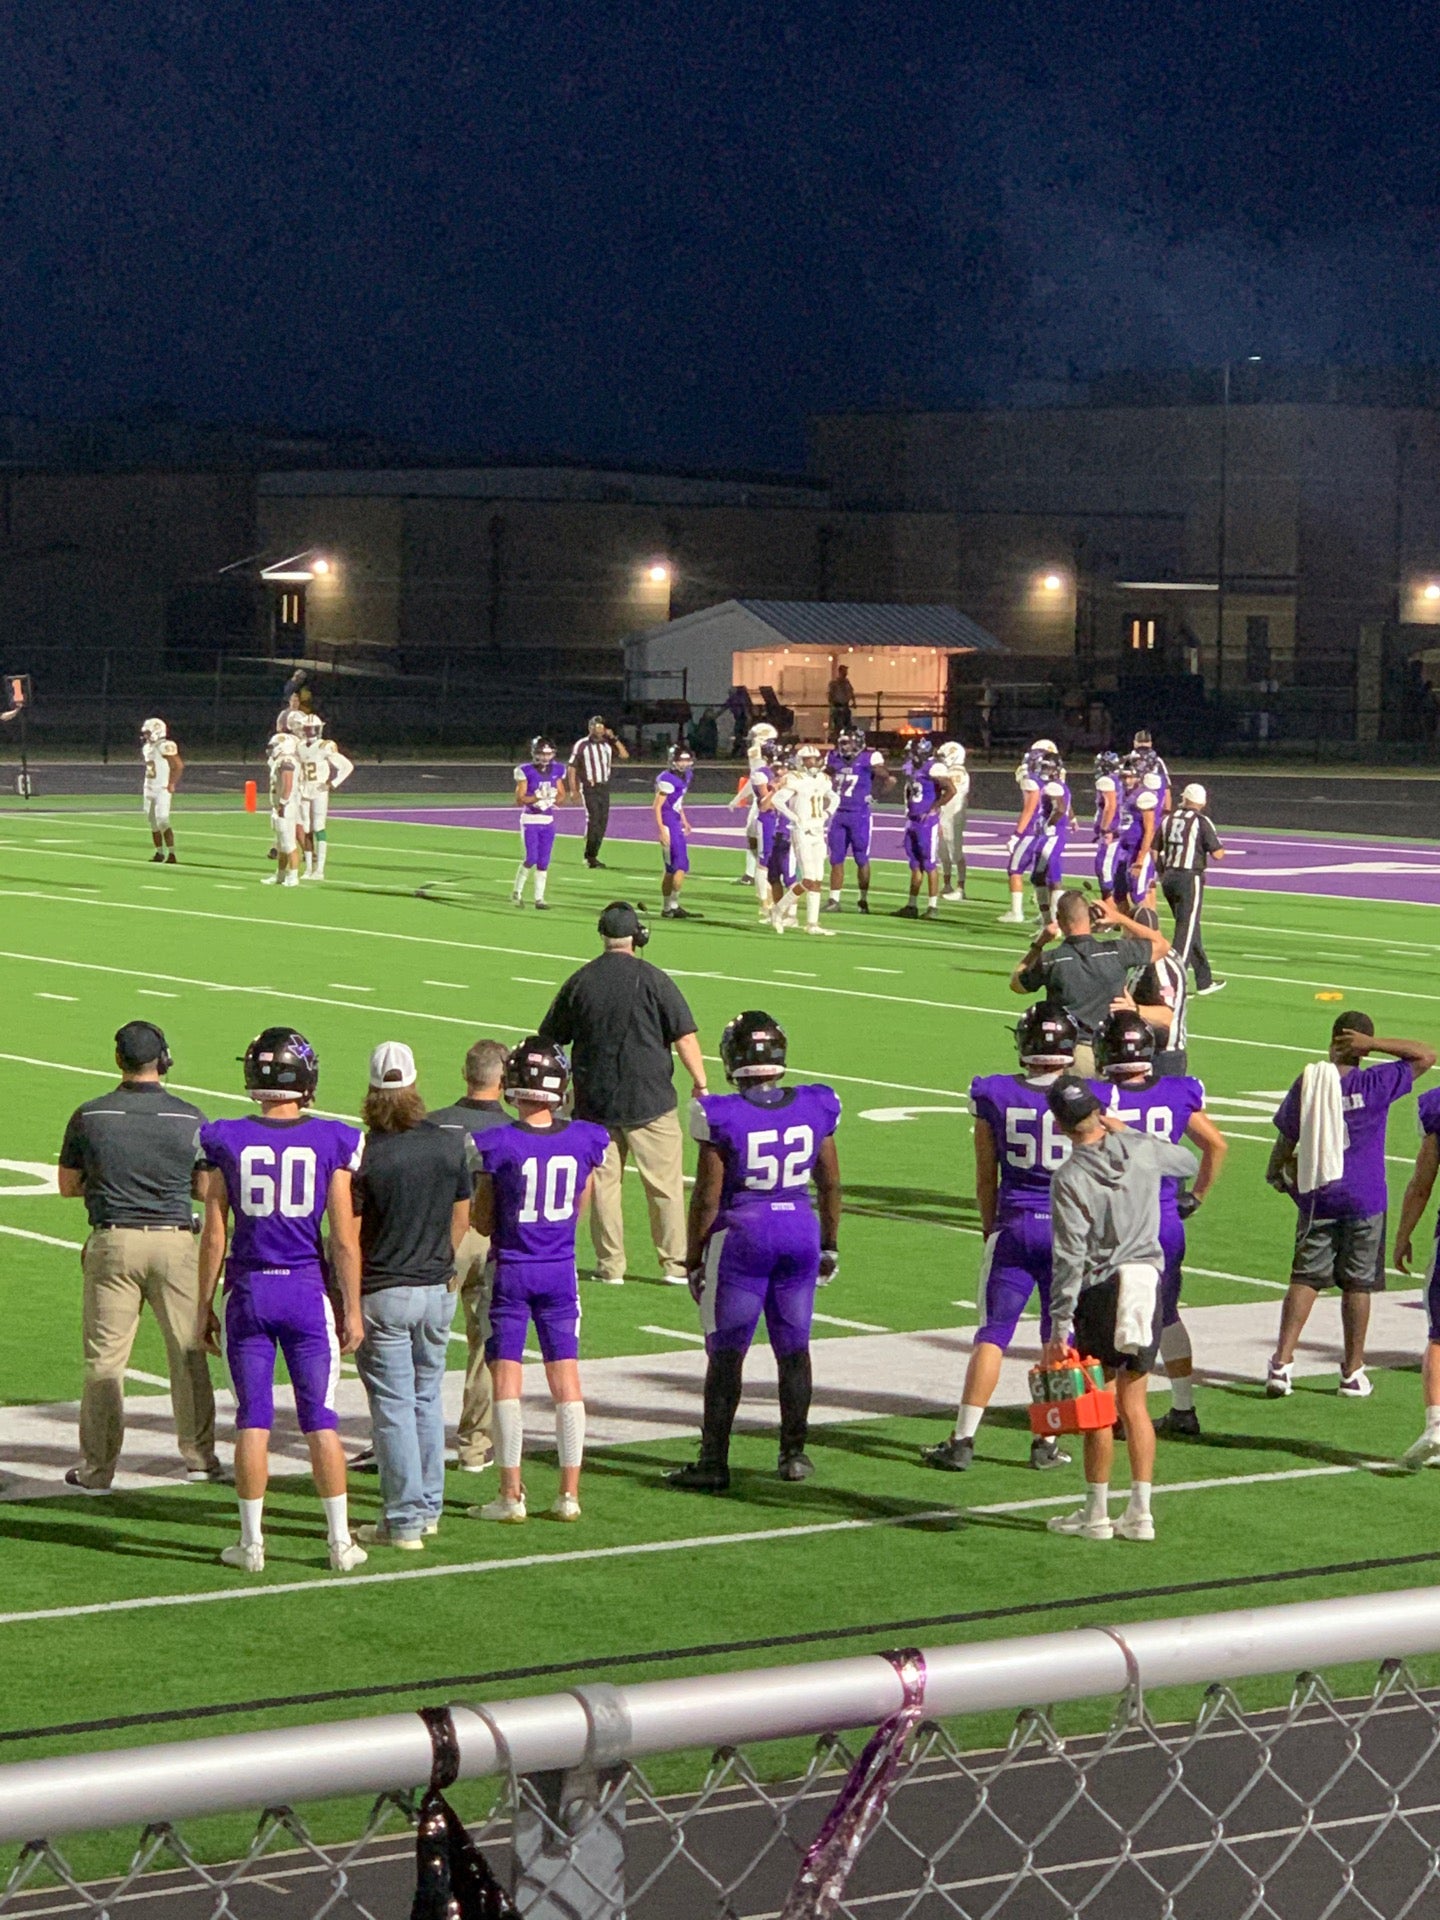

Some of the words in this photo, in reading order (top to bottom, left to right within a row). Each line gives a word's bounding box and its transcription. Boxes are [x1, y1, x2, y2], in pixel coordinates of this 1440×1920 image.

[835, 773, 859, 798] 77
[1168, 818, 1186, 843] R
[744, 1124, 814, 1190] 52
[1004, 1106, 1074, 1171] 56
[239, 1145, 317, 1218] 60
[518, 1155, 578, 1223] 10
[1046, 1406, 1062, 1429] G
